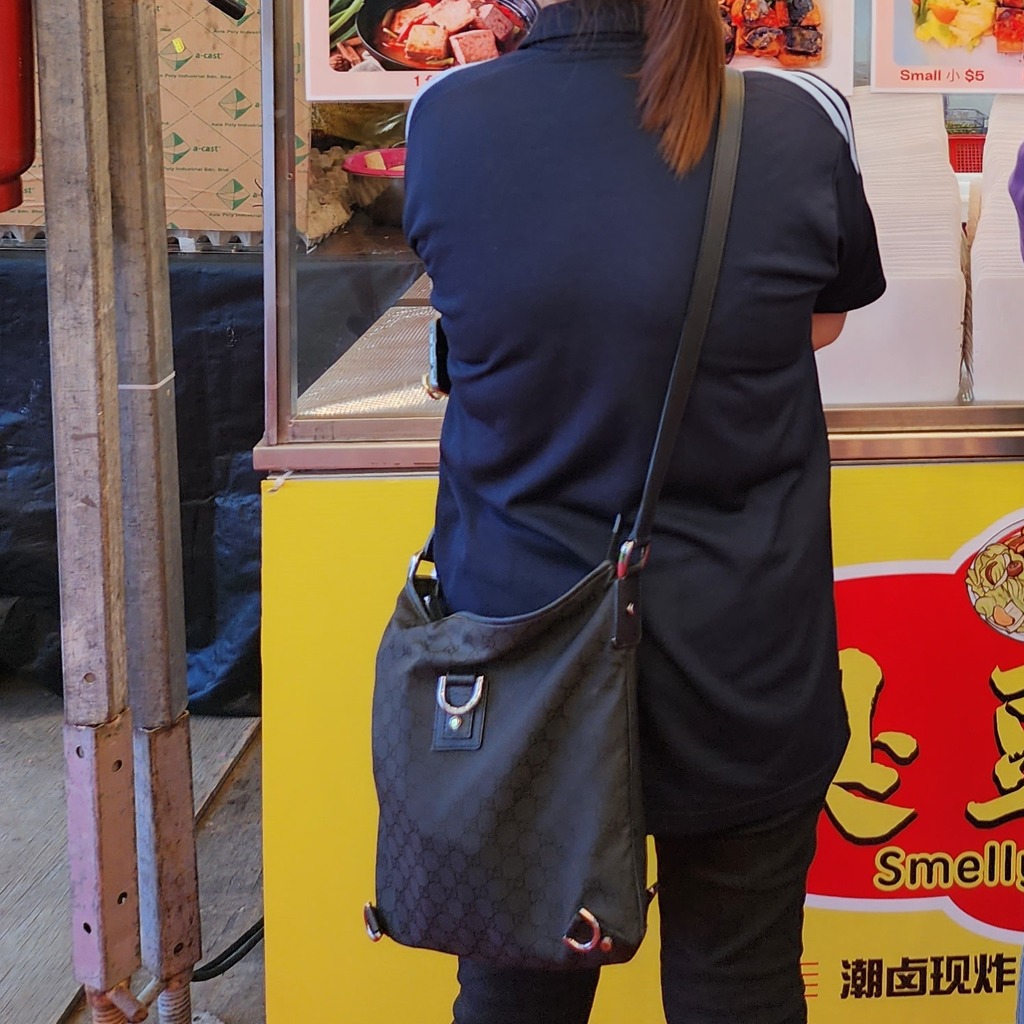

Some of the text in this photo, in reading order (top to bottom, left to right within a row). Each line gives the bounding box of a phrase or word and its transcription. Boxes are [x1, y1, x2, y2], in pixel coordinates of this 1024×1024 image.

[900, 68, 985, 82] Small 小 $5
[840, 952, 1018, 1000] 潮卤现炸
